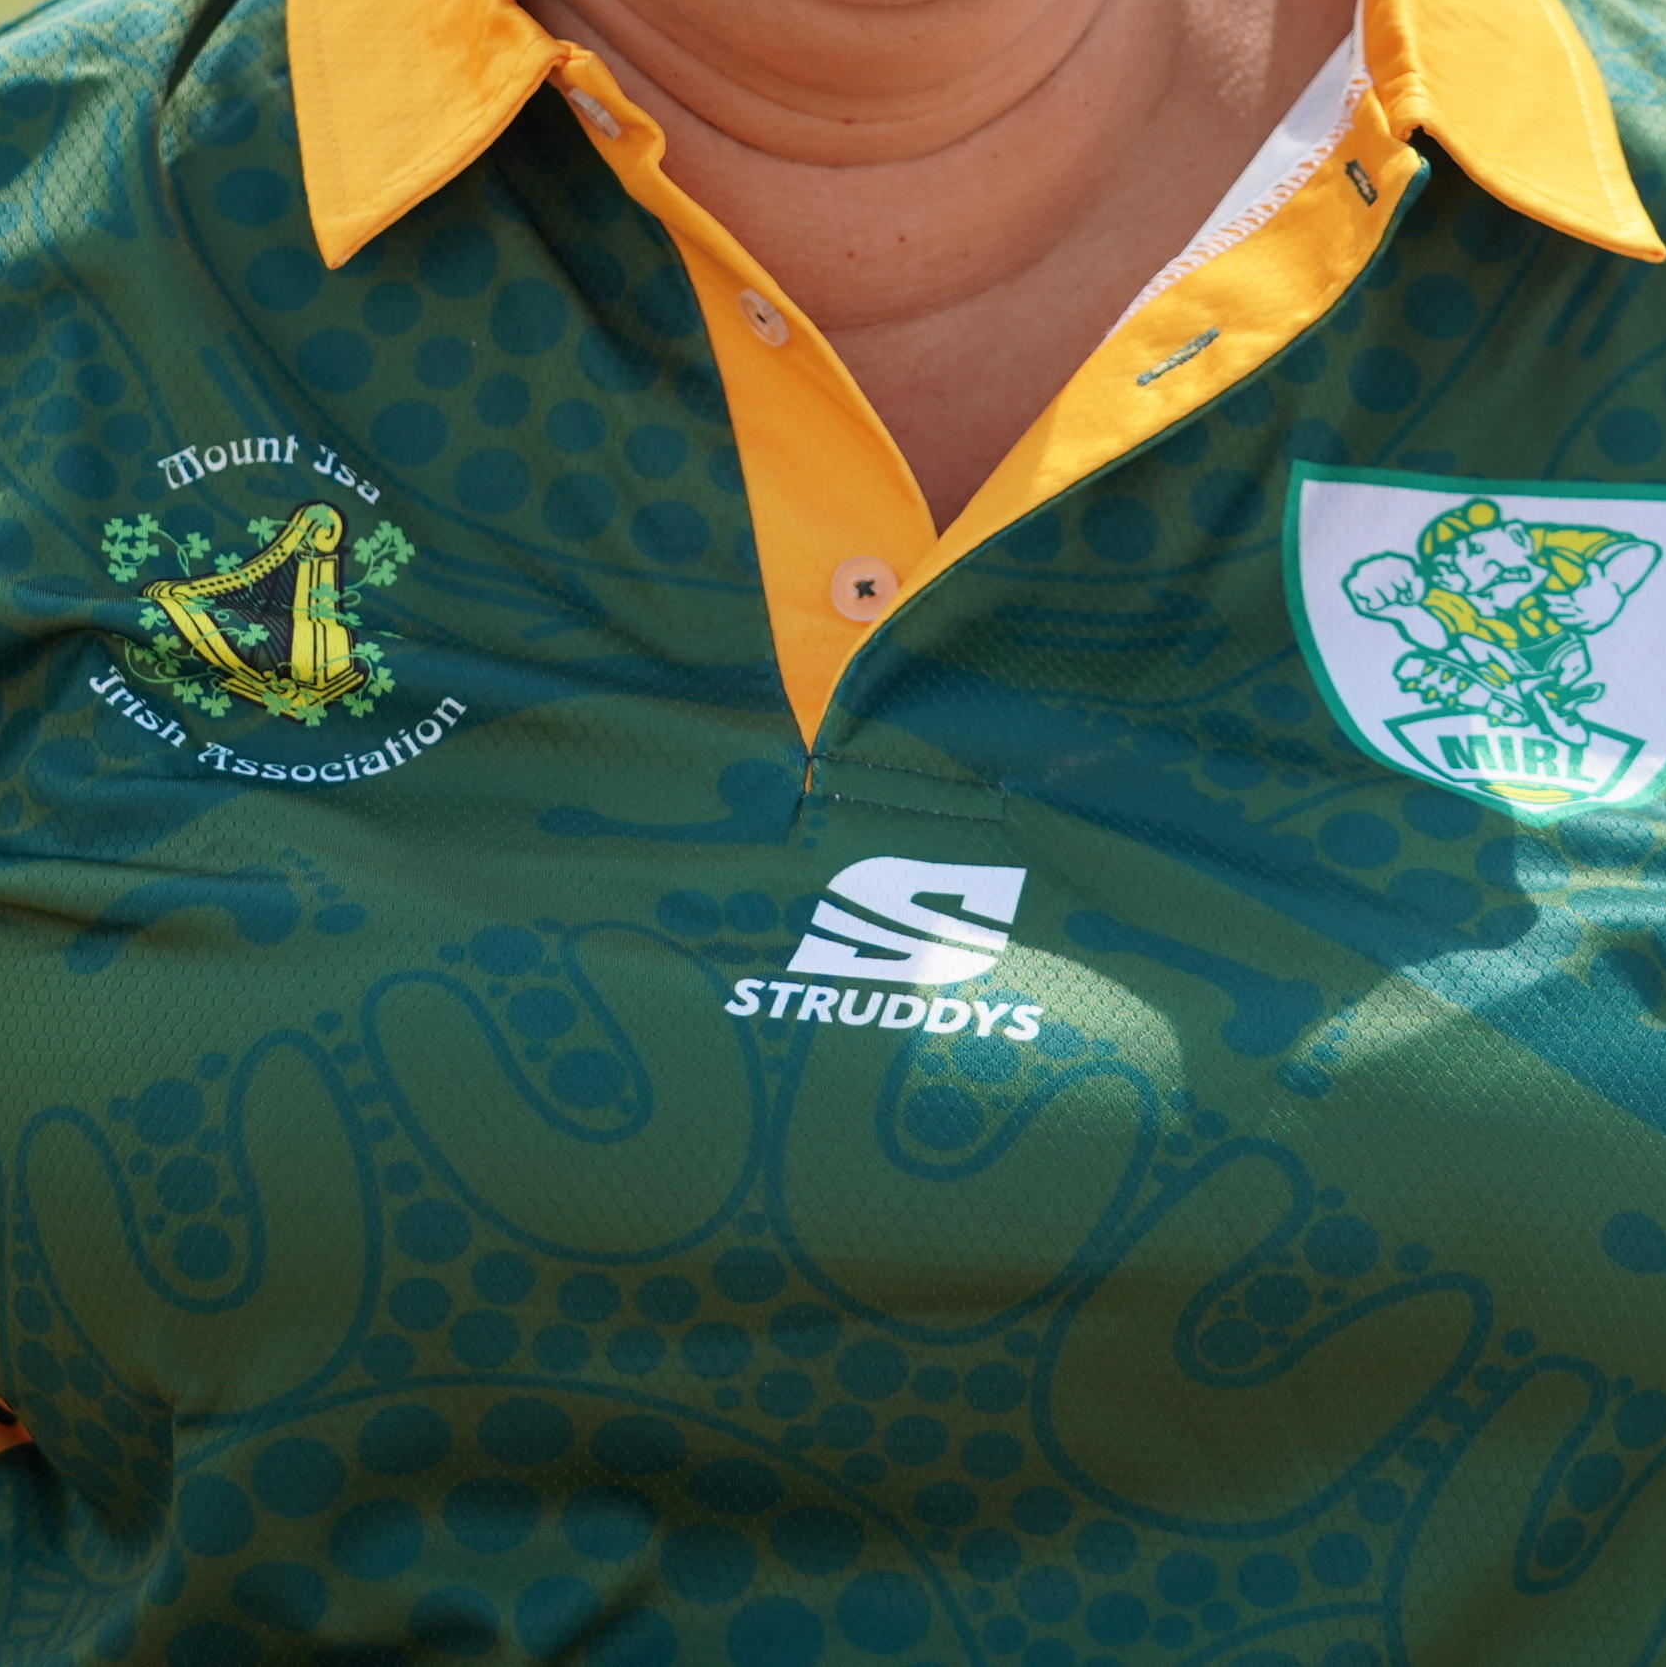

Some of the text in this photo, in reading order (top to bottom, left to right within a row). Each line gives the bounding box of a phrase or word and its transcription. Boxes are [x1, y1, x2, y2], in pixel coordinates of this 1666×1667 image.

[156, 435, 382, 505] Mount Isa
[89, 664, 468, 783] Irish Association
[1437, 734, 1598, 784] MIRL
[724, 978, 1044, 1041] STRUDDYS
